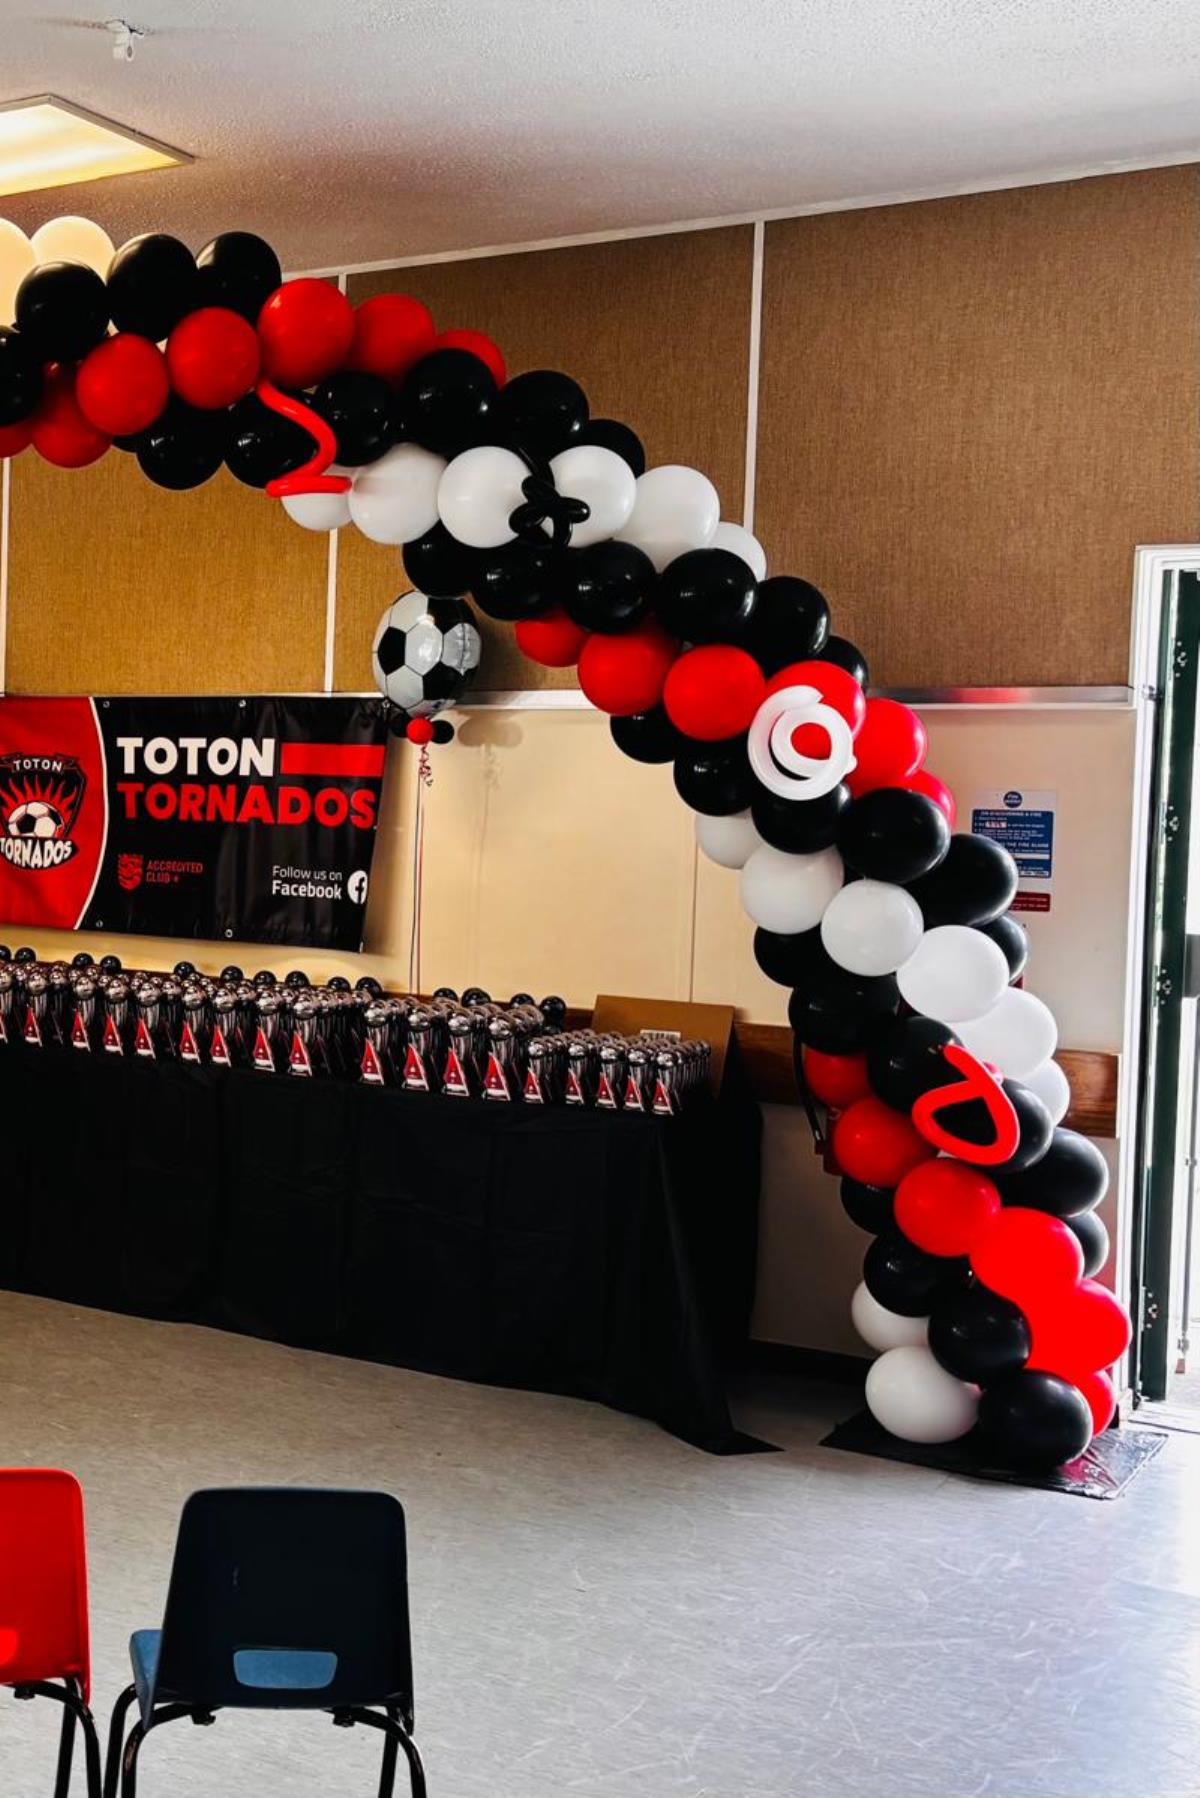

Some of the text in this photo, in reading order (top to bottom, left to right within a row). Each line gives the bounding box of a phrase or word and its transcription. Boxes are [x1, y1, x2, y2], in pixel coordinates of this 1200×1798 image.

[13, 758, 63, 772] TOTON
[117, 737, 276, 777] TOTON
[117, 782, 376, 828] TORNADOS
[0, 837, 72, 869] TORNADOS
[146, 860, 204, 874] ACCREDITED
[272, 865, 343, 881] Follow us on
[145, 871, 171, 883] CLUB
[272, 879, 343, 900] Facebook
